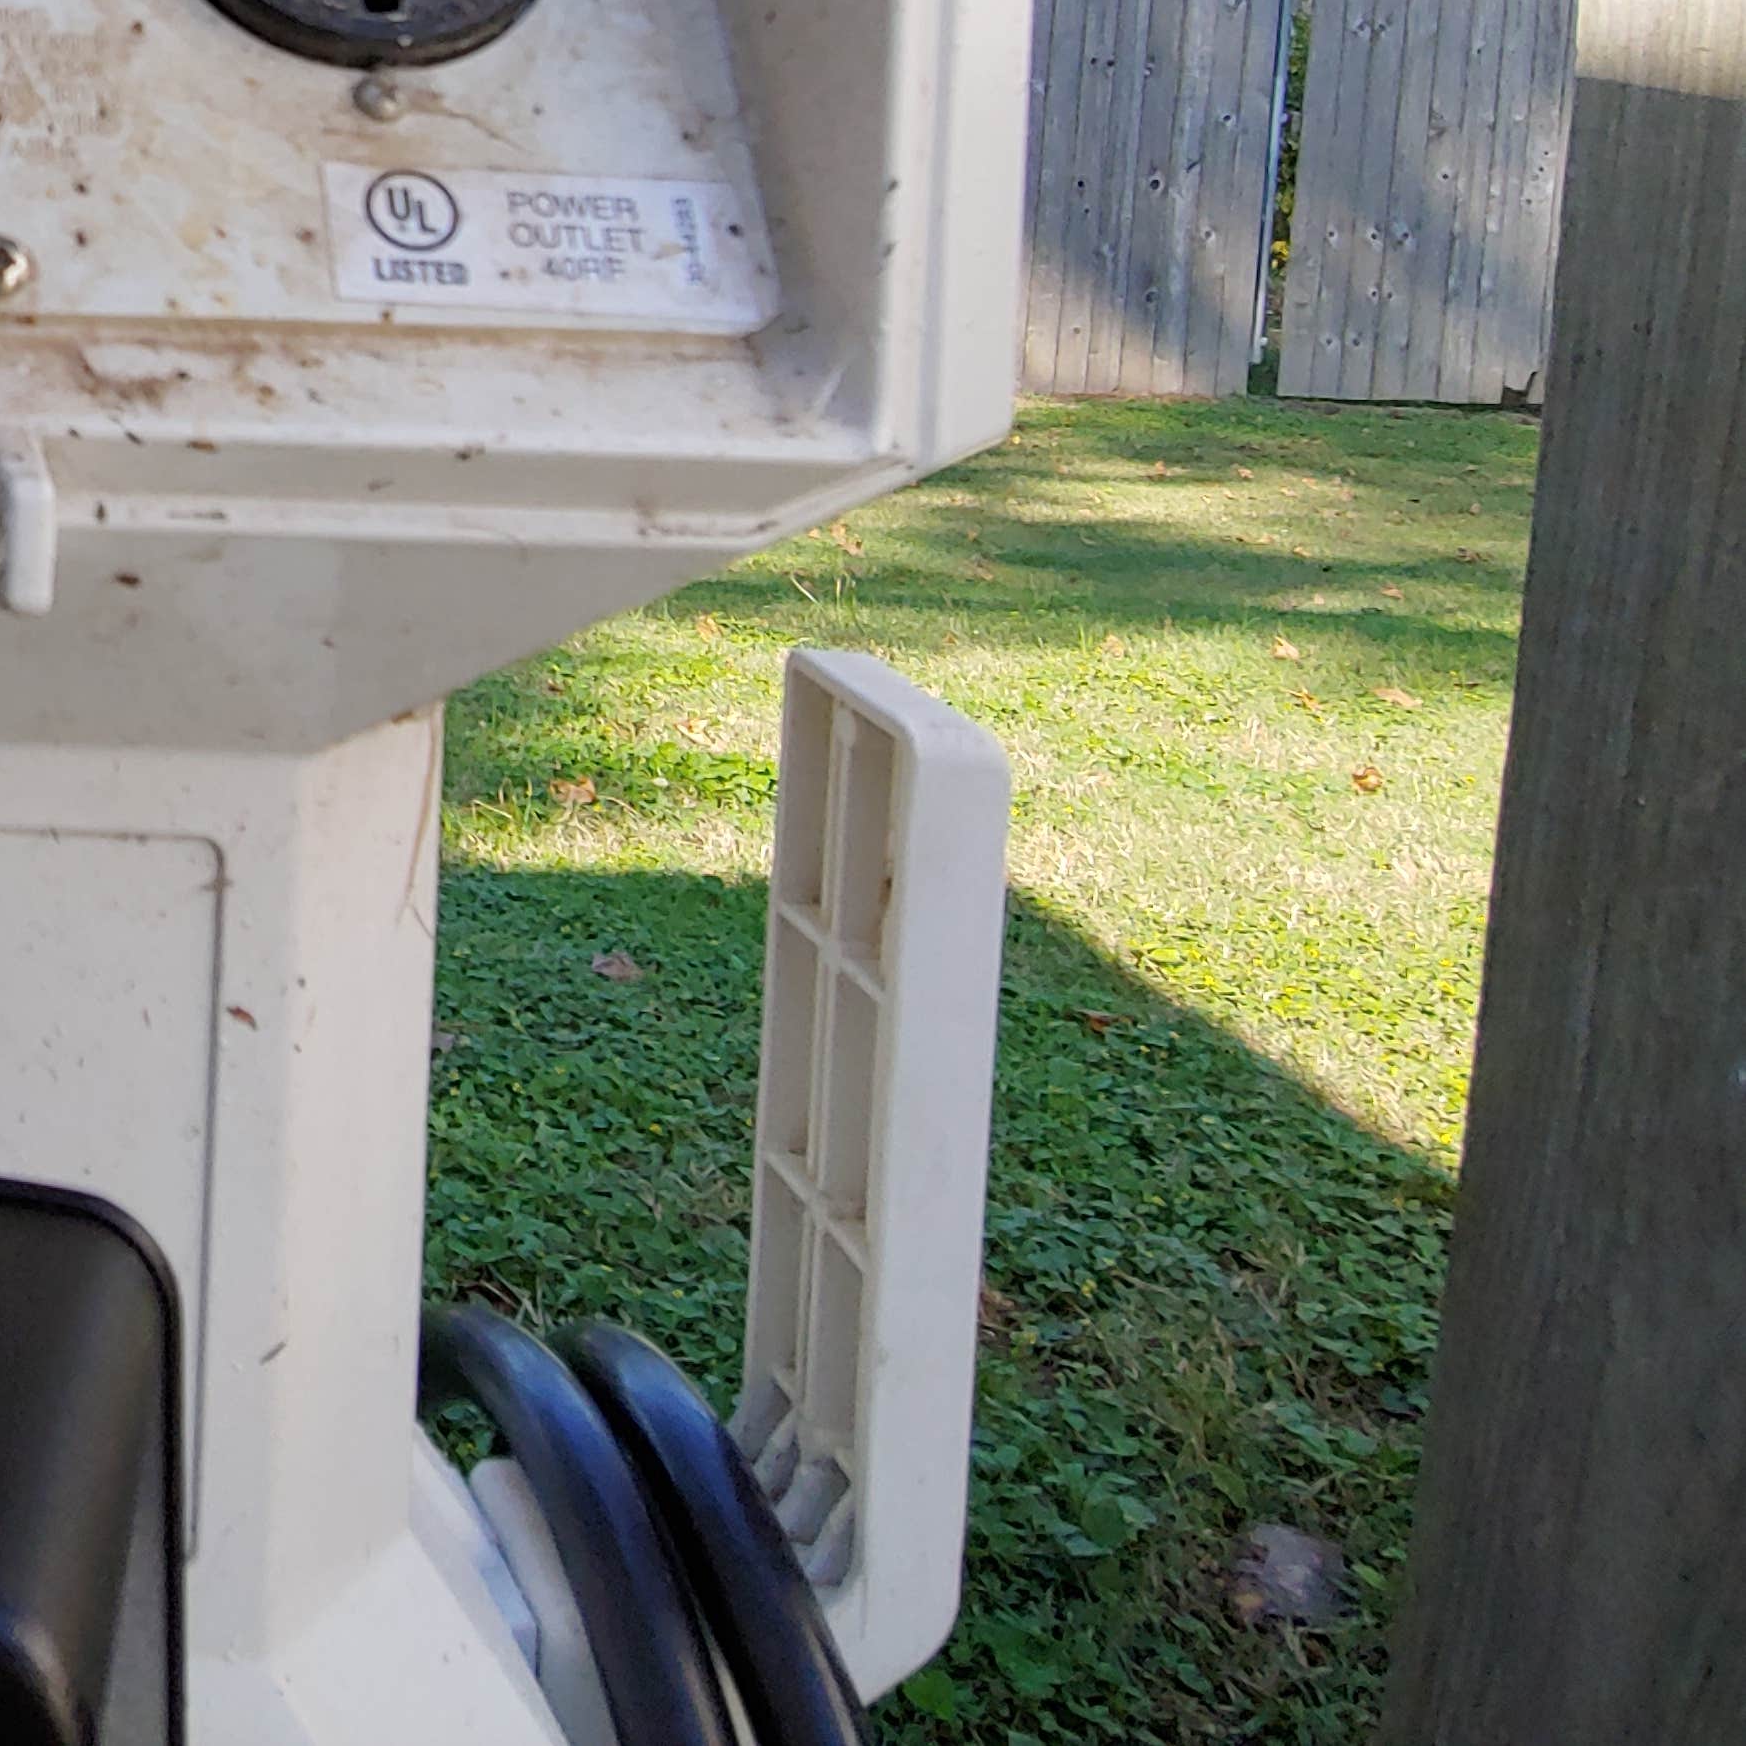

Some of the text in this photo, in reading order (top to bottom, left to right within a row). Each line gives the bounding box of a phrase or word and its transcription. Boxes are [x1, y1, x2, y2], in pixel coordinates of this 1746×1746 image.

[386, 186, 438, 234] UL
[506, 190, 641, 223] POWER
[508, 221, 649, 254] OUTLET
[372, 256, 472, 286] LISTED
